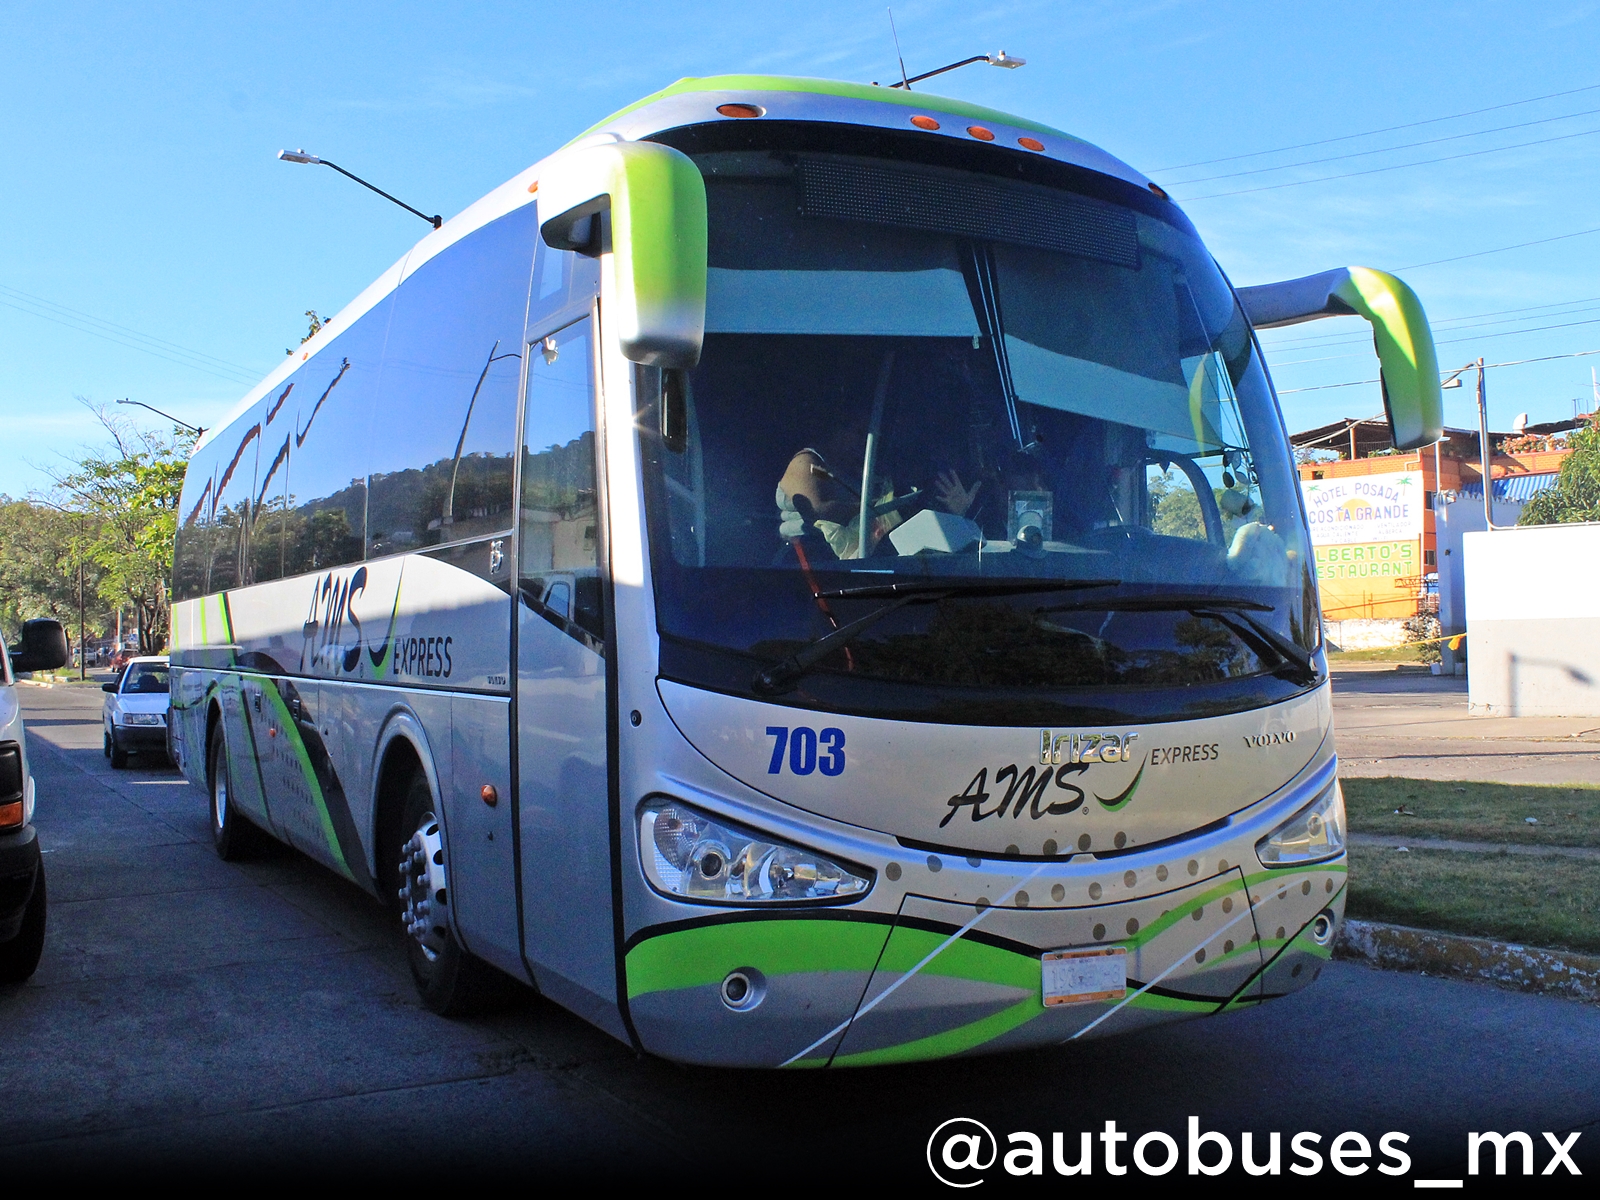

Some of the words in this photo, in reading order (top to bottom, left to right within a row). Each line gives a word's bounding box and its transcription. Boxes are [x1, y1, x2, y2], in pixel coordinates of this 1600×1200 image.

[1313, 485, 1347, 508] HOTEL
[1354, 482, 1399, 503] POSADA
[1308, 505, 1351, 524] COSTA
[1356, 504, 1409, 521] GRANDE
[1315, 543, 1412, 563] LBERTO'S
[1315, 561, 1412, 579] ESTAURANT
[300, 566, 368, 676] AMS
[393, 636, 453, 678] EXPRESS
[765, 726, 846, 777] 703
[1040, 728, 1140, 766] Irizar
[1243, 730, 1297, 749] VOLVO
[1150, 743, 1220, 767] EXPRESS
[939, 762, 1090, 829] AMS
